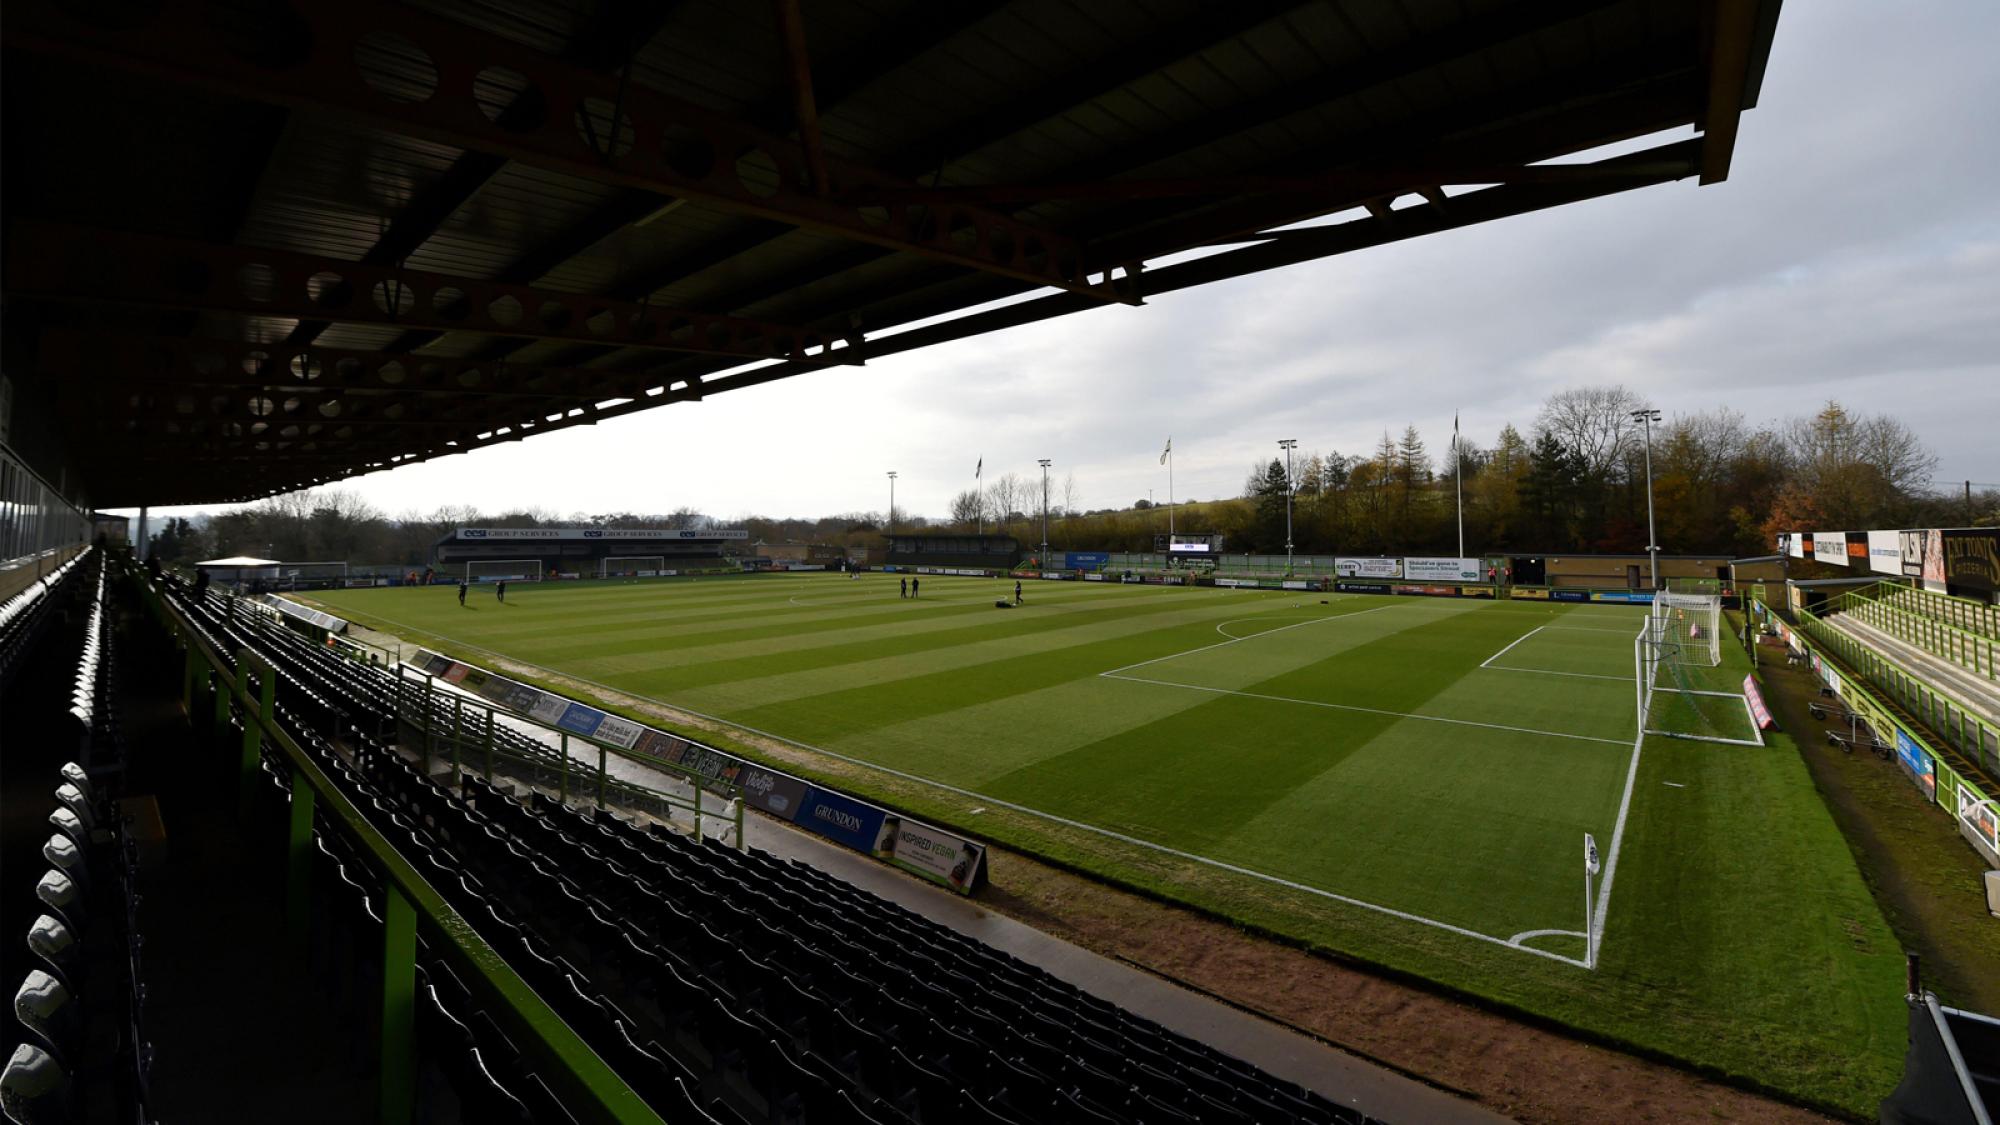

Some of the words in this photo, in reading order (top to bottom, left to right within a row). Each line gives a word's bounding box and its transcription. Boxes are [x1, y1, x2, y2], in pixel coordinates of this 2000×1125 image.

[815, 804, 863, 832] GRUNDON
[898, 831, 932, 851] INSPIRED
[932, 842, 957, 860] VEGAN
